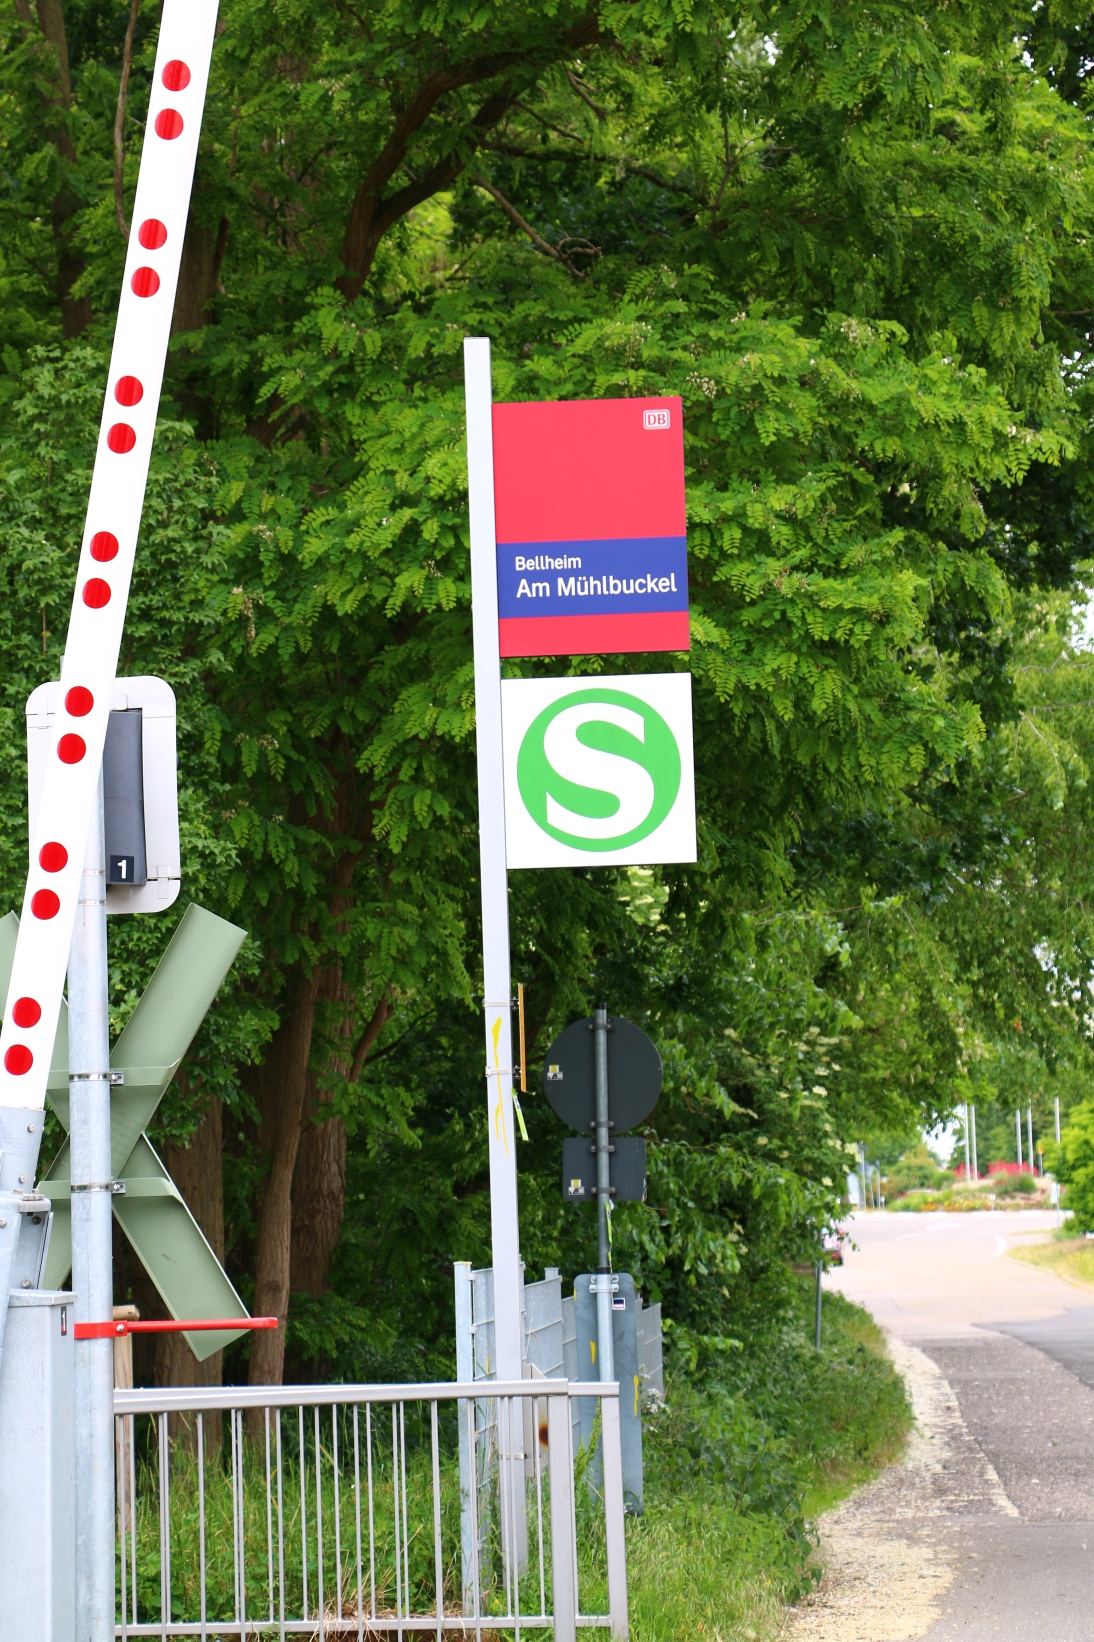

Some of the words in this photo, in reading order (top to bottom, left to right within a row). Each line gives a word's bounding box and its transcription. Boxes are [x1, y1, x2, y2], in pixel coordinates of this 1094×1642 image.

[647, 413, 666, 426] DB
[515, 554, 582, 571] Bellheim
[516, 578, 550, 598] Am
[557, 572, 678, 597] Mühlbuckel
[543, 702, 655, 840] S
[117, 859, 127, 880] 1
